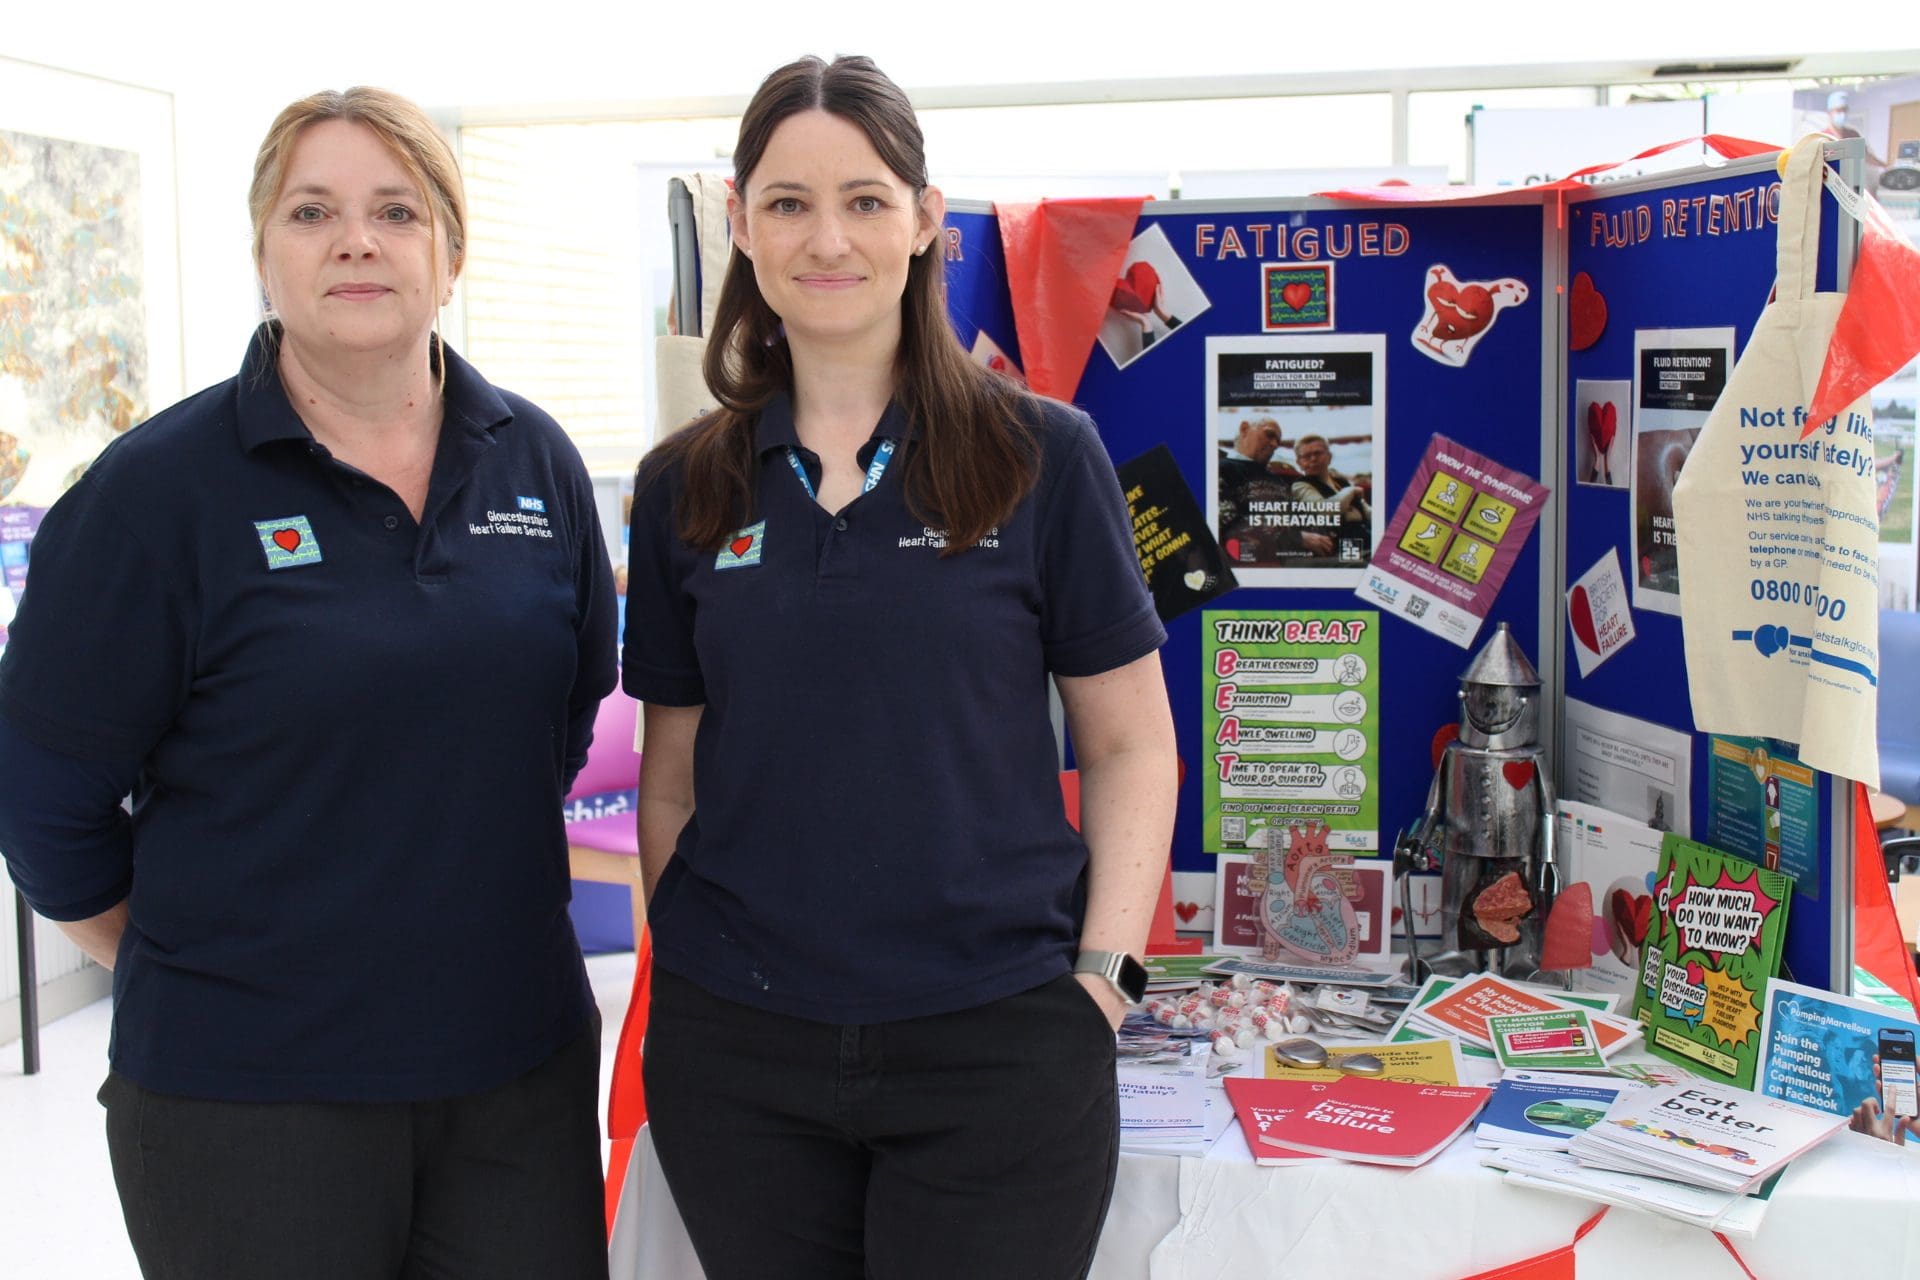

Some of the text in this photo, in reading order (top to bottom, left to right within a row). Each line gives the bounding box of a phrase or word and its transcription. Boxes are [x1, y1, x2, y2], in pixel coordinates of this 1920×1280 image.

[1590, 205, 1652, 248] FLUID
[1662, 182, 1783, 238] RETENTIO
[1195, 222, 1412, 261] FATIGUED
[1265, 359, 1325, 370] FATIGUED?
[1654, 357, 1712, 368] FLUID RETENTION?
[1255, 382, 1275, 390] FLUID
[1740, 407, 1873, 444] Not like
[1822, 441, 1874, 477] lately?
[1435, 451, 1533, 505] KNOW THE SYMPTOMS
[1741, 470, 1770, 486] We
[1776, 473, 1806, 485] can
[520, 498, 543, 510] NHS
[1249, 501, 1341, 512] HEART FAILURE
[1746, 499, 1762, 508] We
[1764, 500, 1781, 508] are
[487, 510, 549, 526] Gloucestershire
[1249, 514, 1341, 526] IS TREATABLE
[1747, 512, 1770, 520] NHS
[1773, 513, 1800, 524] talking
[469, 523, 553, 538] Heart Failure Service
[1748, 531, 1768, 540] Our
[1770, 532, 1800, 541] service
[898, 537, 926, 549] Heart
[1142, 527, 1172, 554] WHAT
[1154, 531, 1192, 561] GONNA
[1654, 531, 1677, 546] IS TRE
[1750, 546, 1796, 556] telephone
[1838, 546, 1850, 556] to
[1750, 559, 1762, 569] by
[1828, 559, 1852, 572] need
[1592, 581, 1618, 613] SOCIETY
[1750, 579, 1800, 604] 0800
[1216, 622, 1364, 642] THINK B.E.A.T
[1599, 614, 1618, 639] HEART
[1602, 624, 1628, 653] FAILURE
[1217, 650, 1316, 676] BREATHLESSNESS
[1217, 685, 1289, 710] EXHAUSTION
[1218, 718, 1312, 743] ANKLE SWELLING
[1218, 755, 1320, 780] TIME TO SPEAK TO
[1230, 774, 1324, 784] YOUR GP SURGERY
[1222, 804, 1324, 813] FIND OUT MORE SEARCH
[1287, 841, 1324, 872] Aorta
[1236, 888, 1248, 896] to
[1270, 889, 1291, 898] Right
[1688, 891, 1752, 912] HOW MUCH
[1678, 908, 1760, 932] DO YOU WANT
[1292, 926, 1318, 940] Right
[1688, 928, 1748, 950] TO KNOW?
[1650, 948, 1661, 961] YOU
[1644, 974, 1657, 986] PAC
[1666, 966, 1686, 982] YOUR
[1473, 991, 1488, 1004] Big
[1481, 987, 1496, 998] My
[1664, 978, 1706, 1003] DISCHARGE
[1718, 984, 1742, 998] HELP WITH
[1465, 996, 1476, 1006] to
[1662, 992, 1682, 1006] PACK
[1712, 1000, 1742, 1015] YOUR HEART
[1507, 1014, 1577, 1022] MARVELLOUS
[1716, 1010, 1735, 1022] FAILURE
[1791, 1006, 1872, 1036] PumpingMarvellous
[1774, 1030, 1819, 1051] Join the
[1773, 1044, 1822, 1066] Pumping
[1772, 1056, 1832, 1082] Marvellous
[1770, 1070, 1834, 1097] Community
[1326, 1098, 1349, 1107] Your
[1352, 1102, 1381, 1112] guide
[1678, 1089, 1739, 1110] Eat
[1768, 1084, 1838, 1111] on Facebook
[1250, 1106, 1274, 1114] Your
[1314, 1102, 1392, 1124] heart
[1661, 1098, 1774, 1134] better
[1304, 1110, 1396, 1135] failure
[1674, 1116, 1690, 1124] and
[1694, 1118, 1714, 1128] your
[1716, 1124, 1733, 1132] risk
